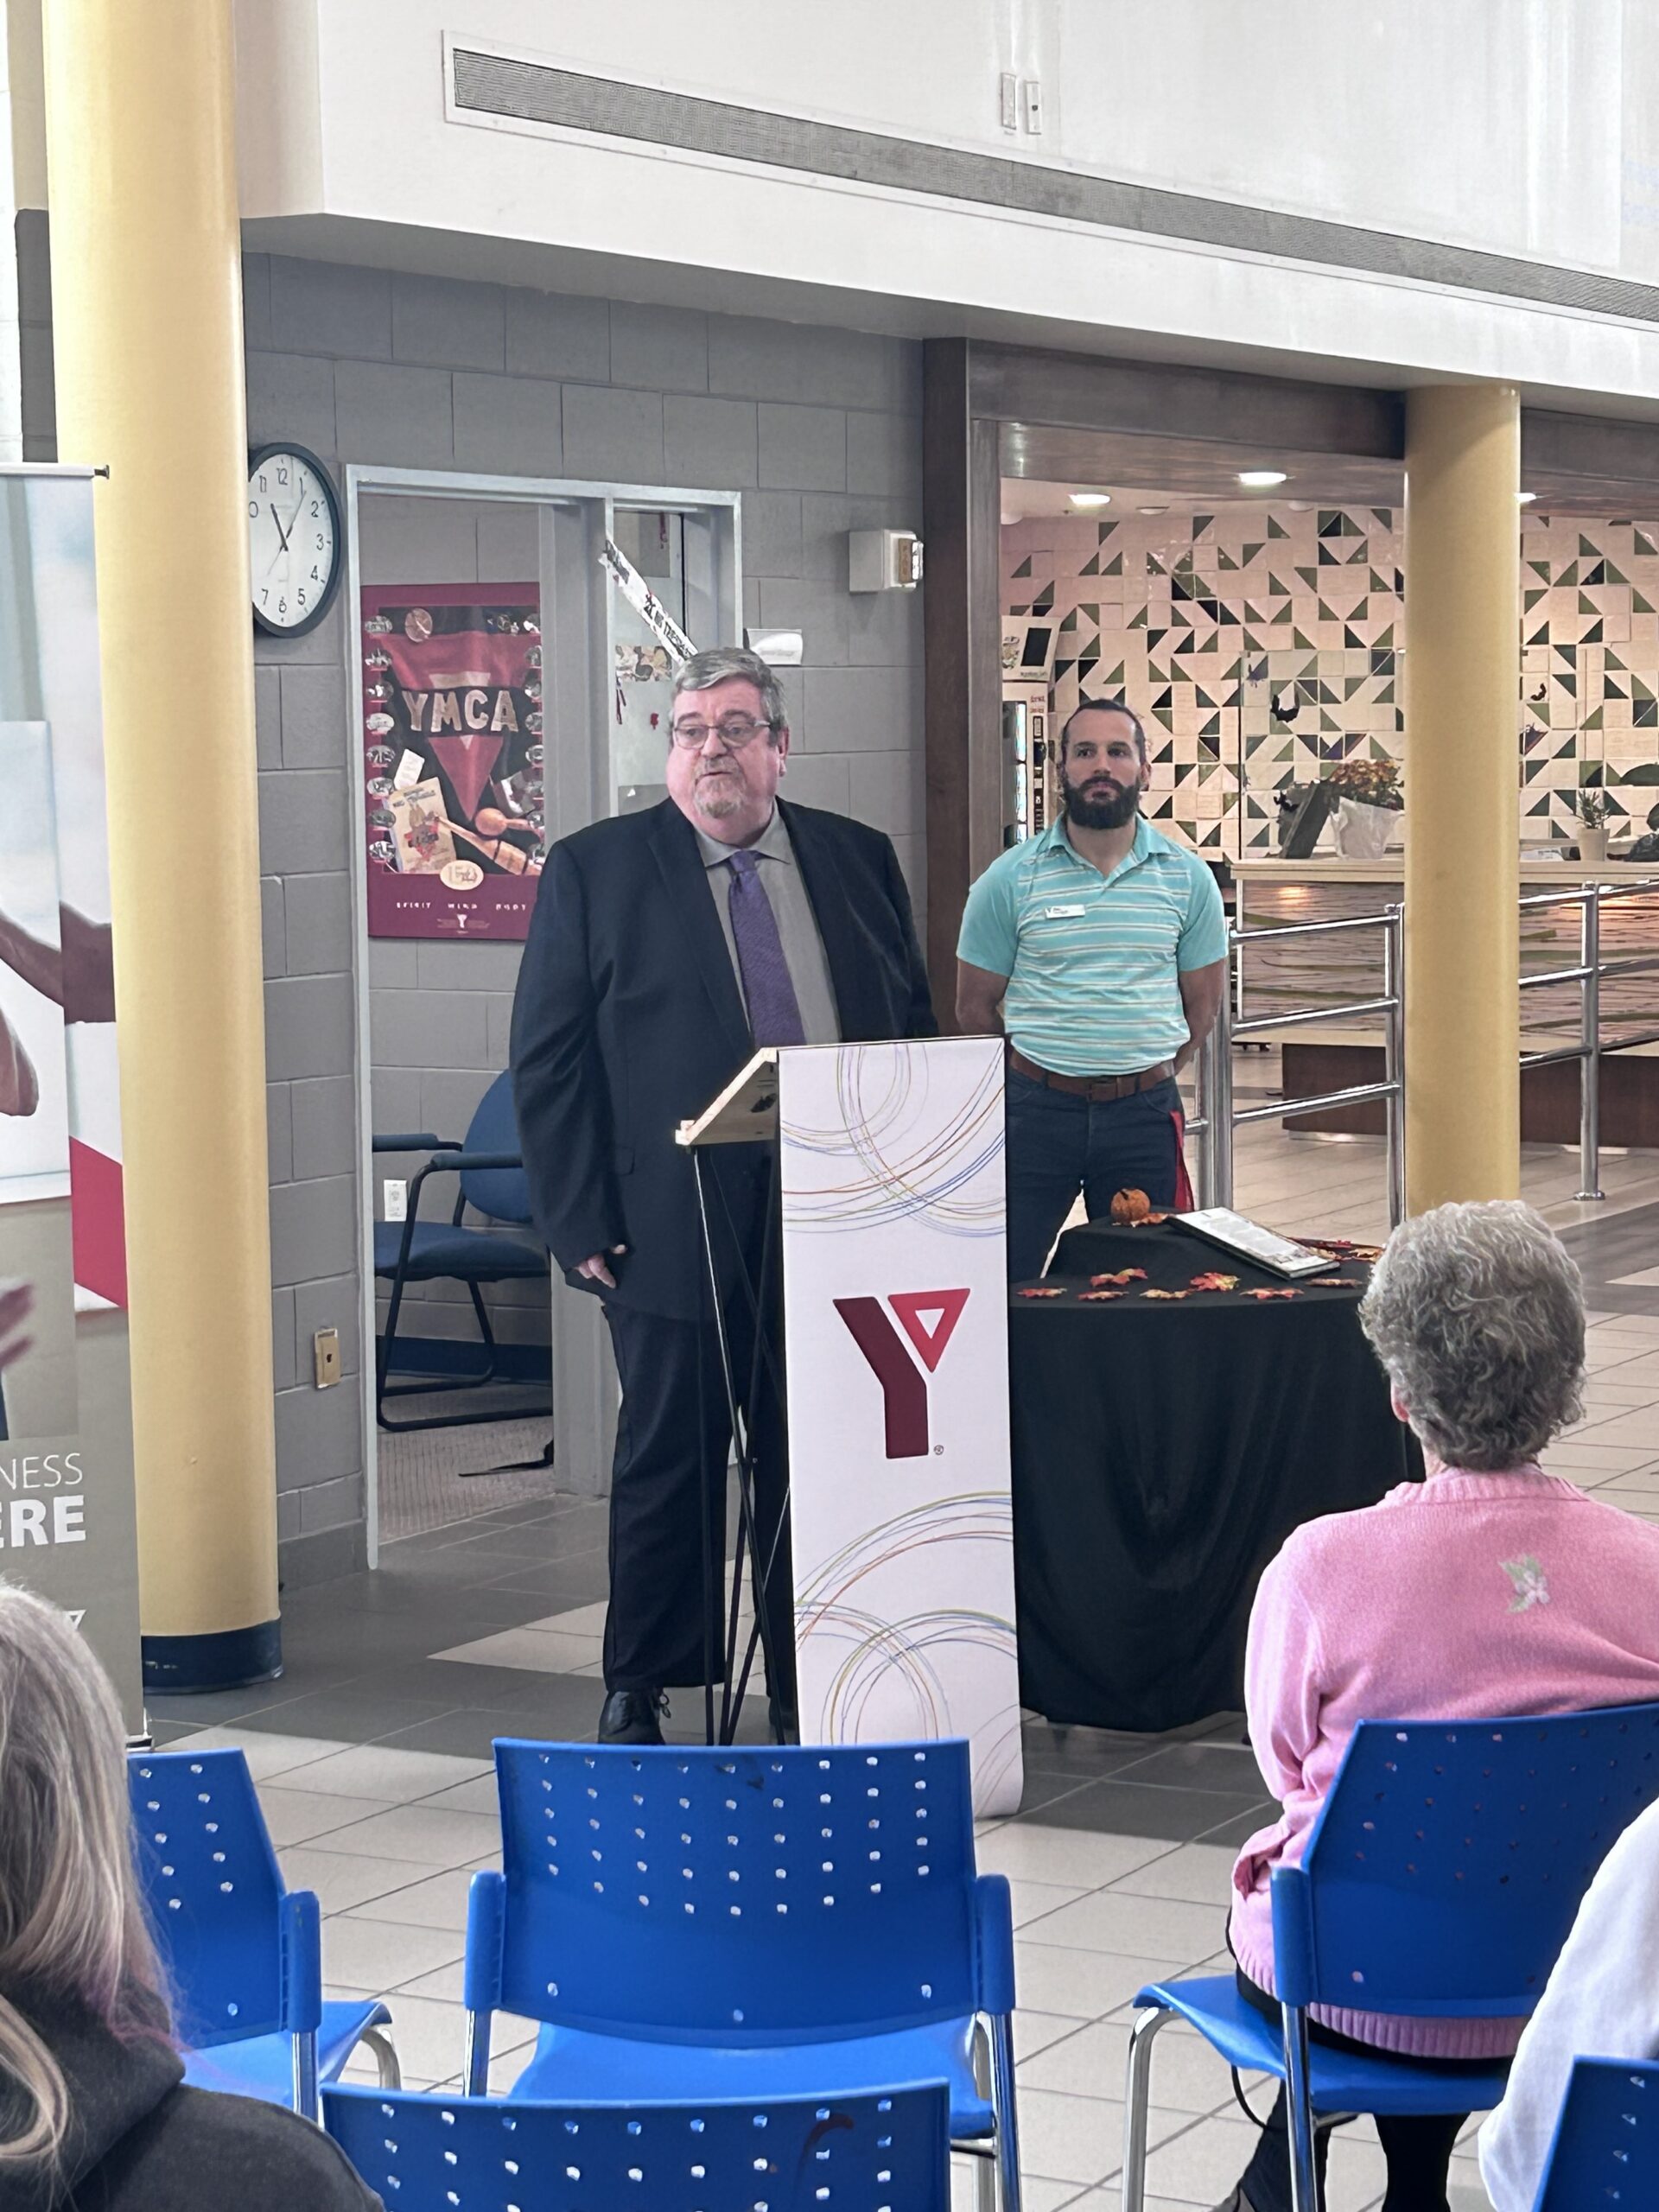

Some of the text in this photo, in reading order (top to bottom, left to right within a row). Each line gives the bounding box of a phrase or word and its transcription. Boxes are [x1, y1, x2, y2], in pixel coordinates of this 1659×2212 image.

[276, 467, 289, 486] 12
[248, 500, 258, 518] 0
[311, 500, 320, 518] 2
[316, 533, 325, 551] 3
[310, 564, 319, 581] 4
[261, 588, 270, 606] 7
[278, 596, 287, 613] 6
[297, 588, 306, 606] 5
[401, 689, 519, 733] YMCA
[832, 1287, 971, 1459] Y
[0, 1495, 86, 1549] RE
